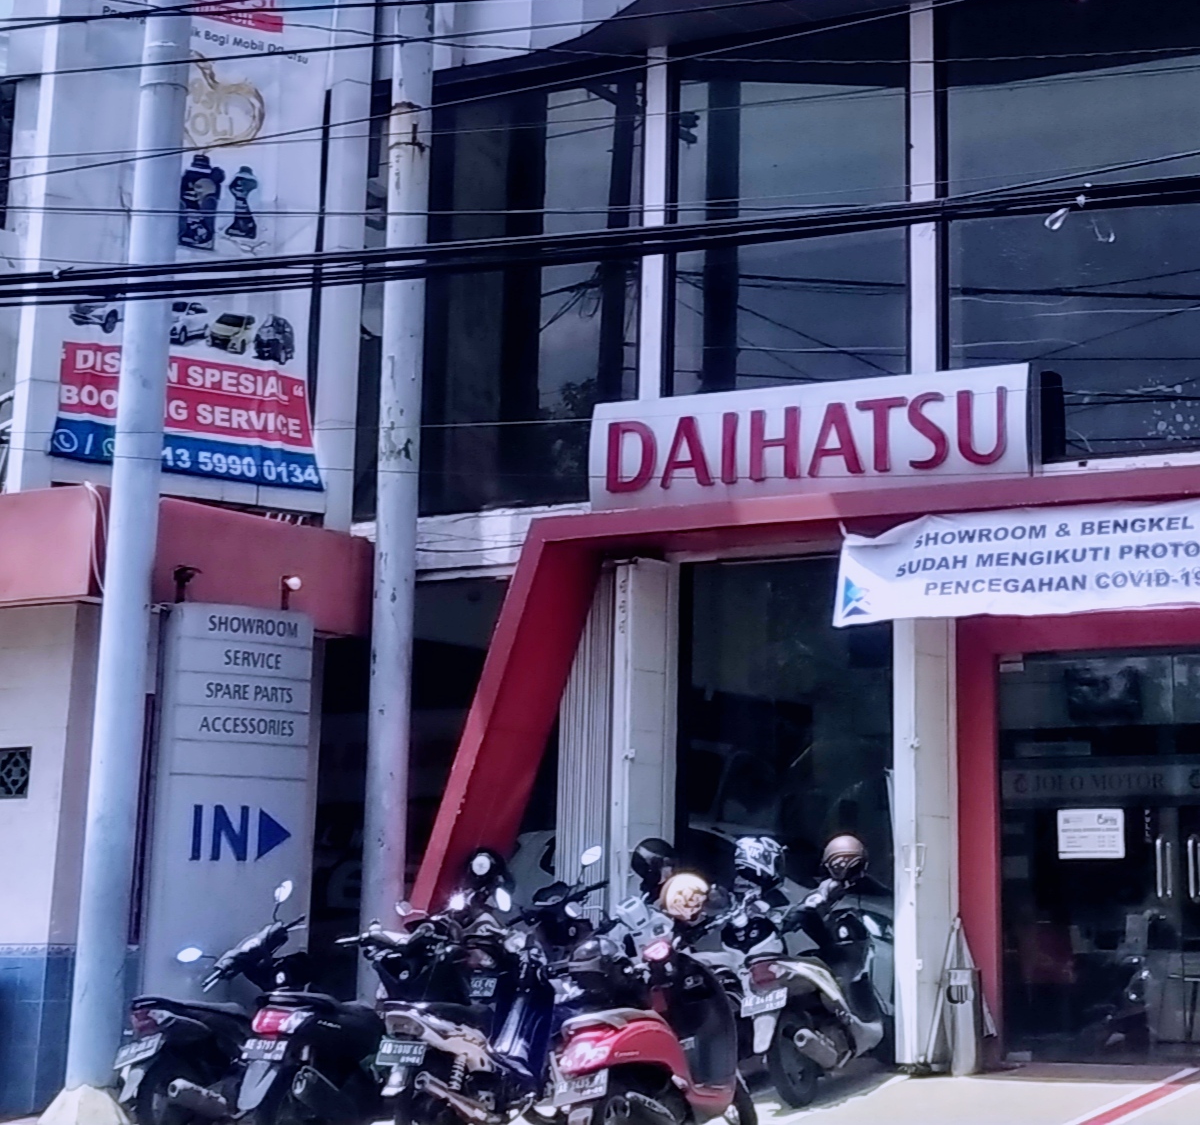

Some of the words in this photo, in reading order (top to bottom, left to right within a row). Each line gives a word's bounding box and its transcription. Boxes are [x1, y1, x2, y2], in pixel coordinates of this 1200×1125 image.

[204, 30, 229, 46] Bagi
[232, 36, 264, 51] Mobil
[75, 350, 179, 383] DISN
[186, 366, 289, 401] SPESIAL
[196, 404, 303, 439] SERVICE
[606, 386, 1009, 494] DAIHATSU
[161, 447, 192, 469] 13
[197, 451, 257, 478] 5990
[263, 460, 319, 484] 0134
[913, 524, 1047, 549] SHOWROOM
[1055, 523, 1071, 538] &
[1081, 516, 1194, 536] BENGKEL
[896, 555, 968, 577] SUDAH
[975, 546, 1111, 568] MENGIKUTI
[924, 574, 1087, 596] PENCEGAHAN
[208, 615, 298, 638] SHOWROOM
[224, 649, 282, 670] SERVICE
[205, 682, 250, 700] SPARE
[254, 685, 293, 704] PARTS
[199, 716, 294, 737] ACCESSORIES
[189, 804, 250, 862] IN
